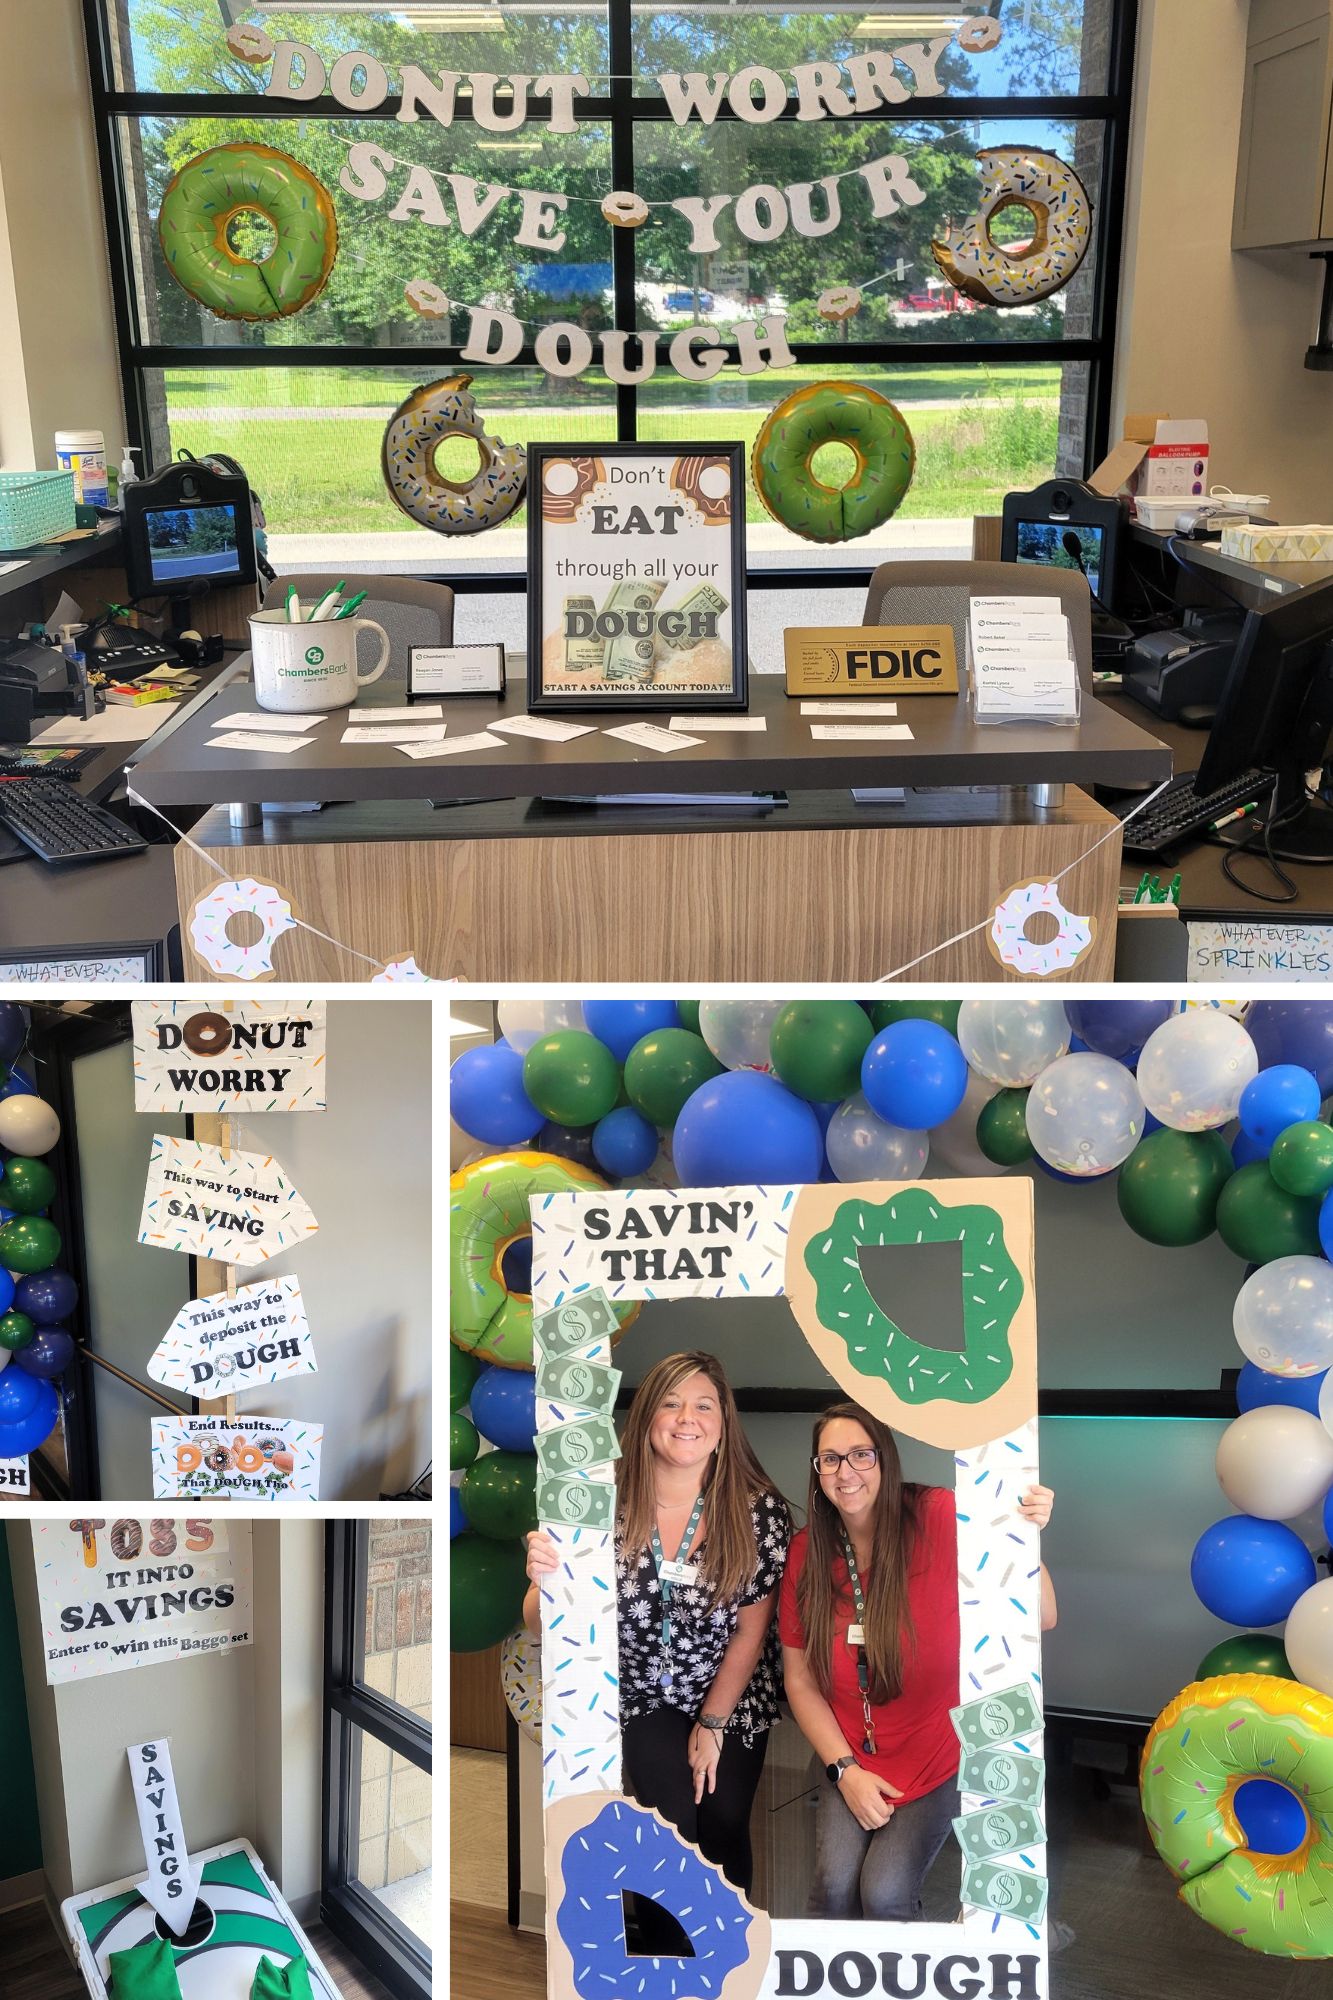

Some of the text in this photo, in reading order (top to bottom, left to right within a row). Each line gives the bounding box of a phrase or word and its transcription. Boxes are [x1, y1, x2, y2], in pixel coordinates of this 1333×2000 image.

[264, 35, 957, 134] DONUT WORRY
[338, 140, 927, 254] SAVE YOUR
[460, 302, 798, 387] DOUGH
[610, 466, 666, 484] Don't
[591, 505, 685, 535] EAT
[555, 558, 719, 580] through all your
[564, 610, 719, 638] DOUGH
[277, 663, 348, 677] ChambersBank
[846, 649, 942, 679] FDIC
[543, 683, 731, 692] START A SAVINGS ACCOUNT TODAY!!
[1220, 927, 1306, 942] WHATEVER
[16, 963, 105, 981] WHATEVER
[1196, 948, 1331, 972] SPRINKLES
[168, 1069, 291, 1092] WORRY
[164, 1169, 280, 1204] This way to Start
[167, 1199, 264, 1237] SAVING
[584, 1201, 754, 1241] SAVIN'
[600, 1245, 732, 1282] THAT
[189, 1293, 283, 1328] This way to
[199, 1313, 286, 1345] deposit the
[191, 1337, 302, 1384] DOUGH
[189, 1420, 216, 1431] End
[182, 1478, 289, 1489] That DOUGH Tho
[69, 1518, 214, 1568] TOSS
[105, 1563, 194, 1589] IT INTO
[60, 1584, 235, 1633] SAVINGS
[48, 1631, 249, 1660] Enter to win this Baggo set
[140, 1743, 184, 1899] SAVINGS
[774, 1950, 1041, 2000] DOUGH
